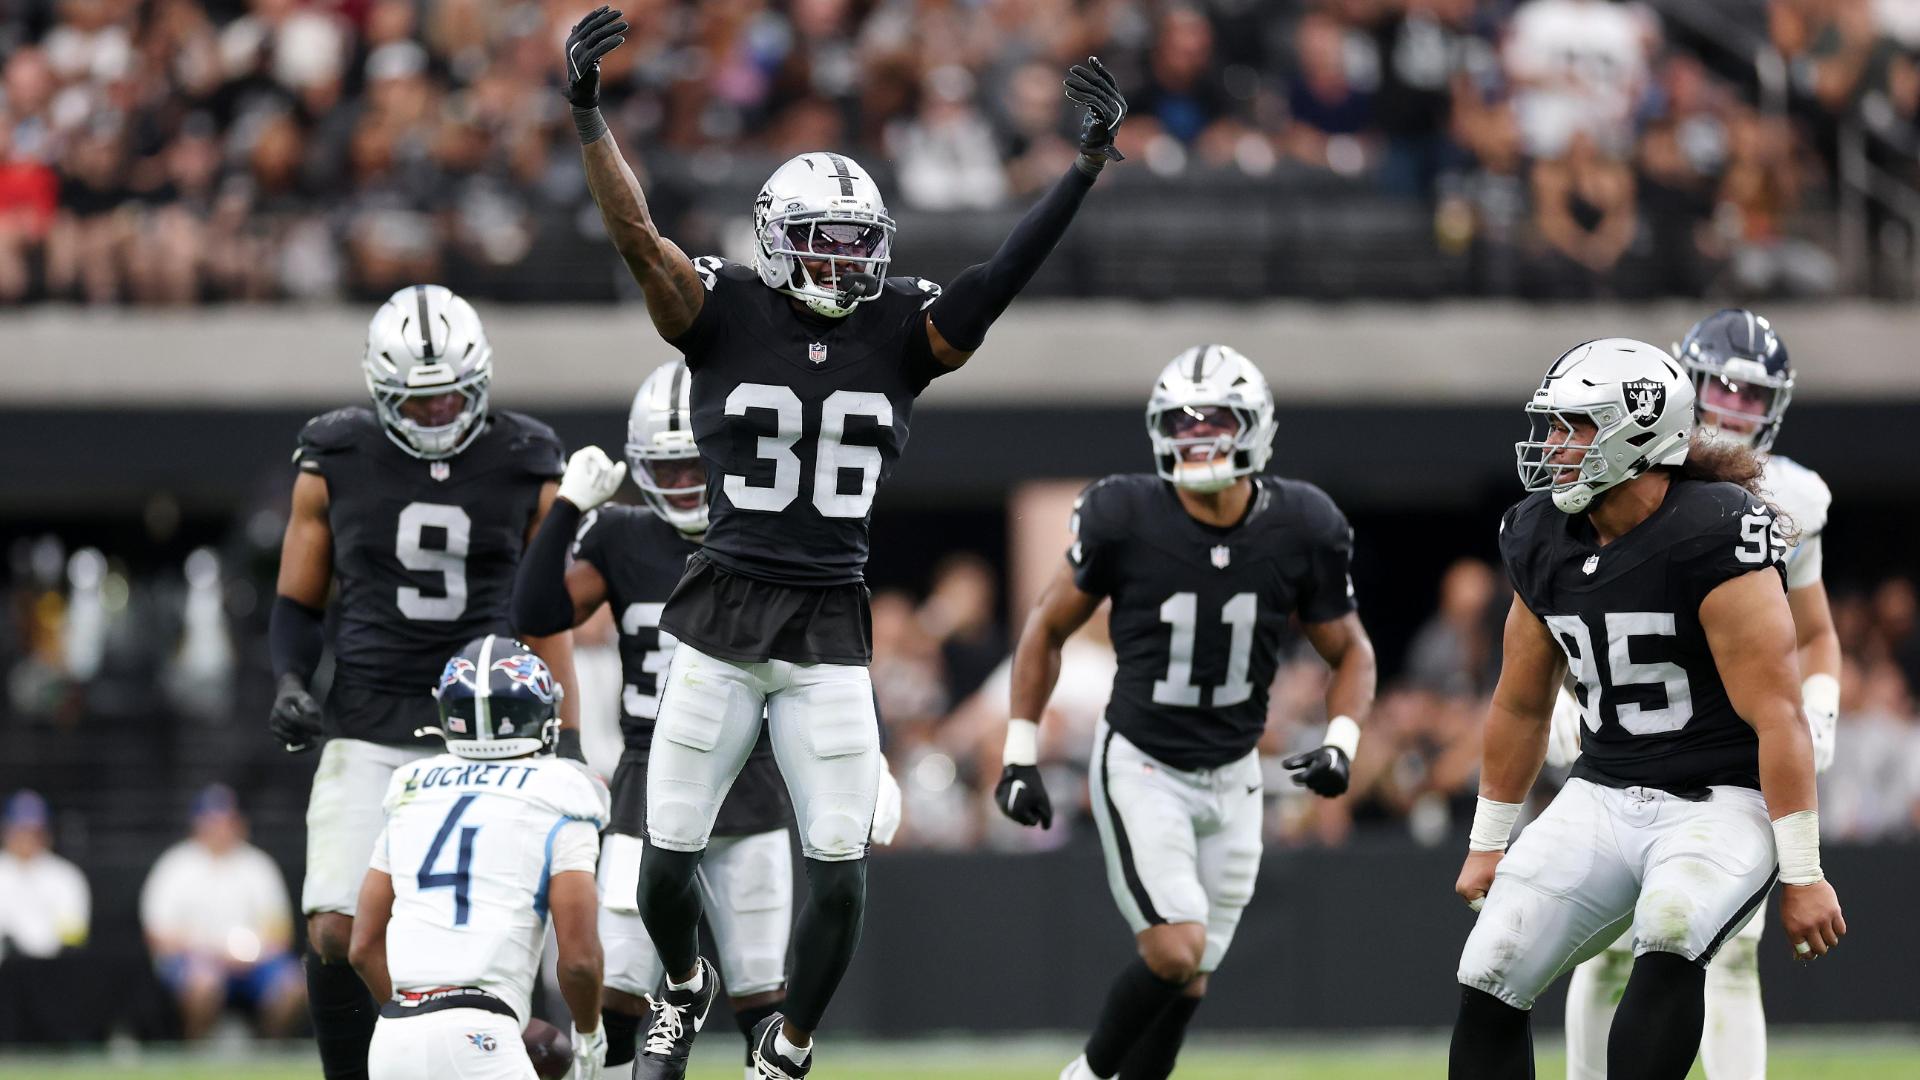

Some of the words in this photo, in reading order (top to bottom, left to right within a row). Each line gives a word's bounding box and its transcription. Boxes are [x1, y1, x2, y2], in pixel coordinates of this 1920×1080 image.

[723, 382, 894, 519] 36
[395, 502, 471, 622] 9
[1152, 592, 1257, 707] 11
[1543, 611, 1694, 736] 95
[404, 764, 538, 792] LOCKETT
[416, 792, 485, 928] 4
